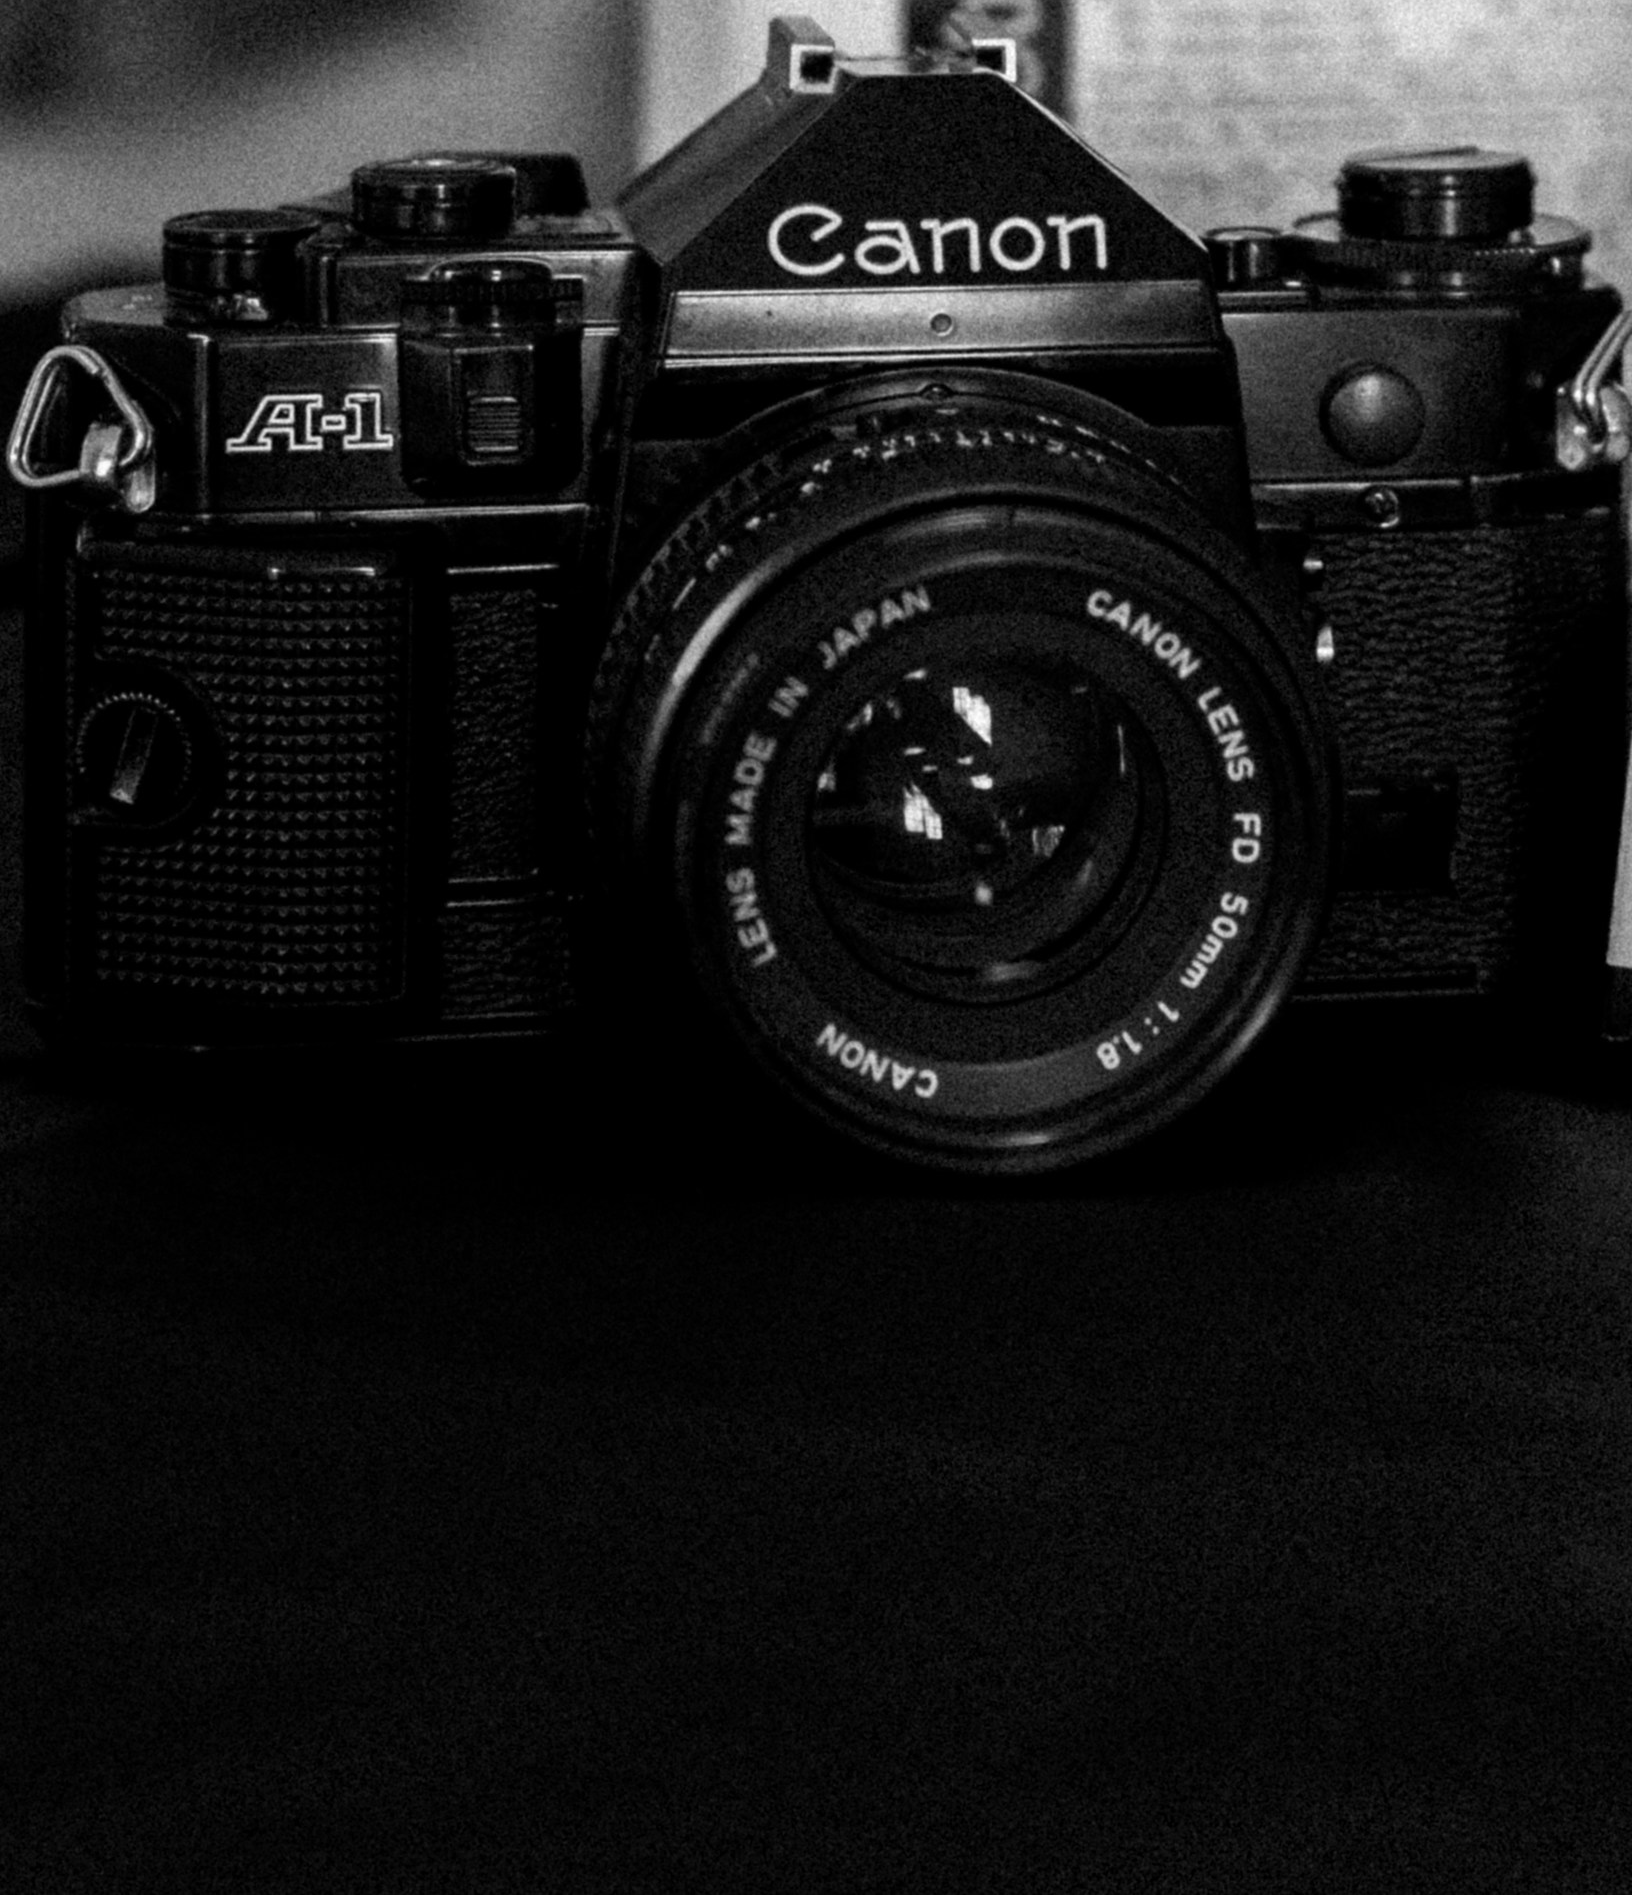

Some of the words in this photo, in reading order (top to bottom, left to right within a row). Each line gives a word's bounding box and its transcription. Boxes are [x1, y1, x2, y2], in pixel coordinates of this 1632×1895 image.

[768, 203, 1108, 276] Canon
[226, 384, 395, 452] A-1
[816, 589, 930, 668] JAPAN
[1086, 590, 1201, 680] CANON
[768, 679, 807, 716] IN
[1197, 686, 1256, 782] LENS
[726, 732, 775, 844] MADE
[1230, 812, 1263, 865] FD
[727, 869, 777, 965] LENS
[1179, 891, 1250, 990] 50mm
[817, 1023, 939, 1099] CANON
